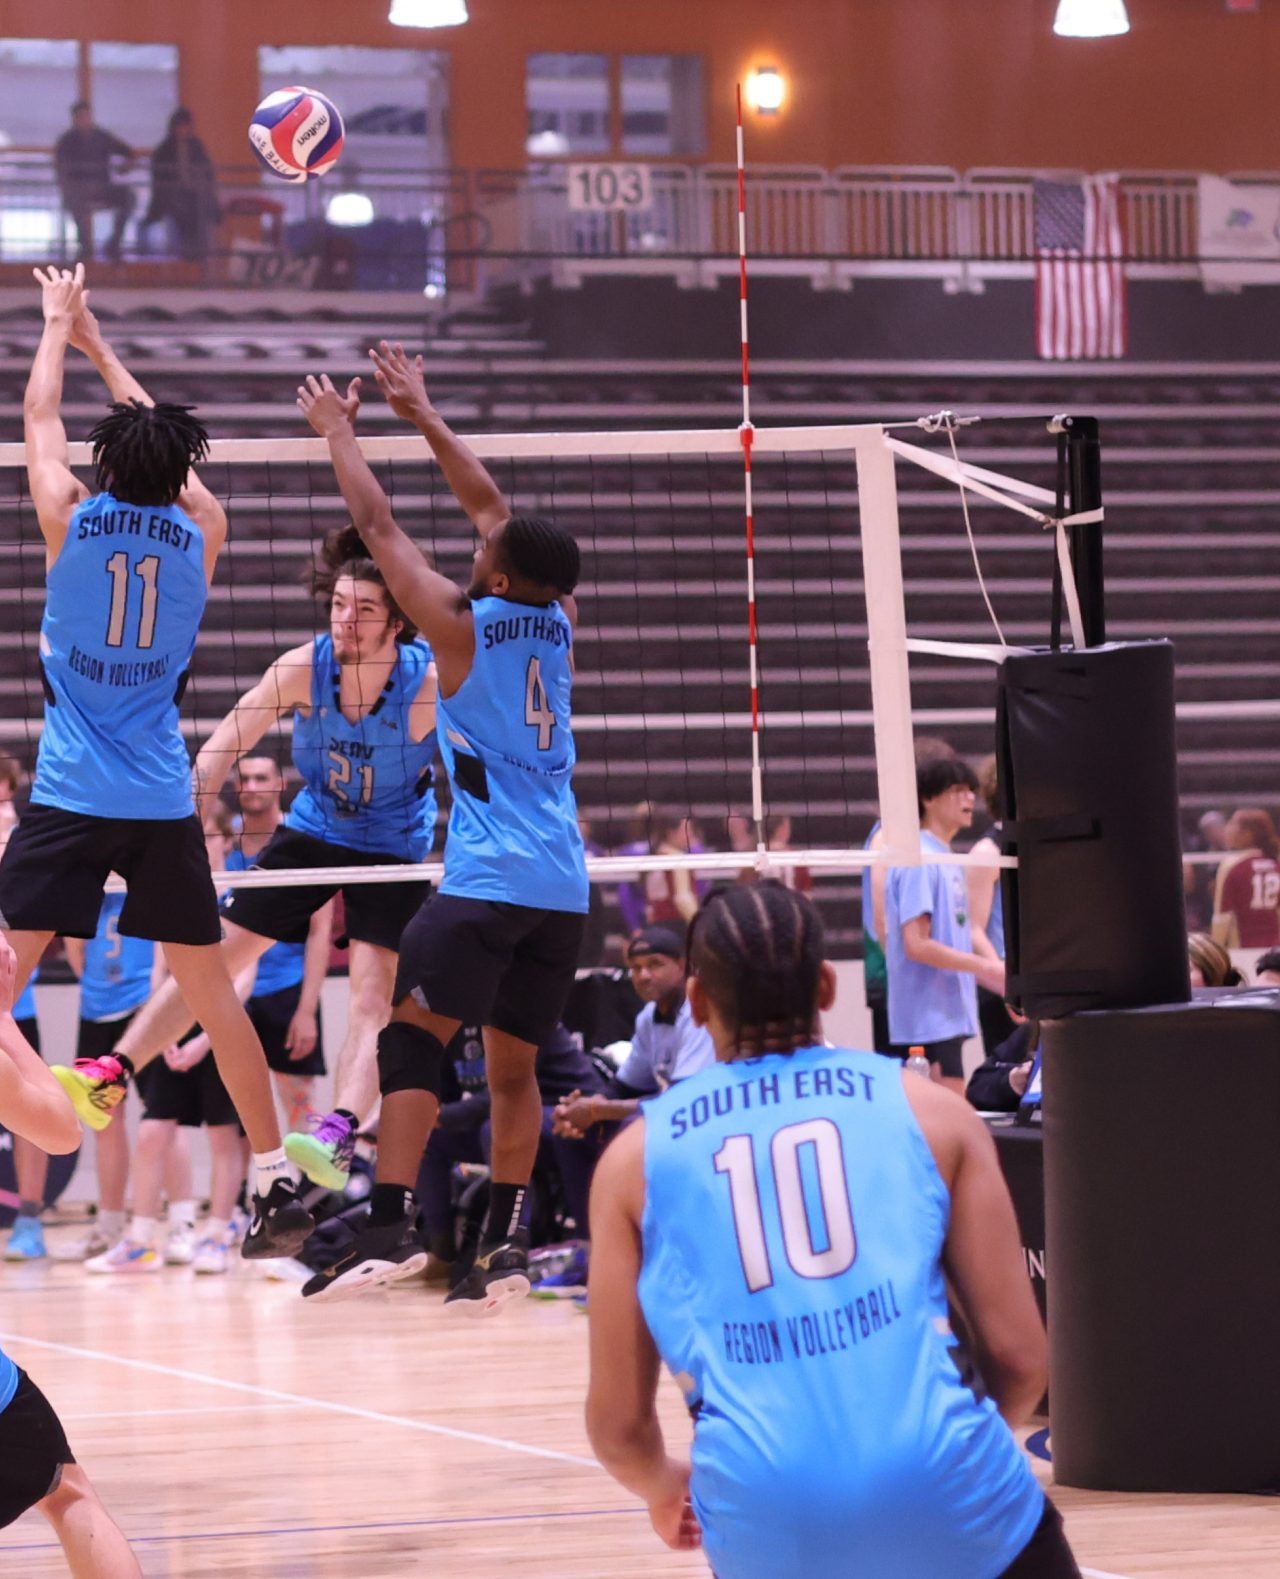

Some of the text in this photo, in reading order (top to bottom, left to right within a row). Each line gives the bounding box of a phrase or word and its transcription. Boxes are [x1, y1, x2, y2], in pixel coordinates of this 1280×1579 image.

[297, 115, 328, 146] molten
[577, 168, 643, 205] 103
[78, 511, 193, 552] SOUTH EAST
[105, 550, 160, 649] 11
[484, 616, 545, 650] SOUTH
[68, 645, 104, 684] REGION
[525, 654, 557, 751] 4
[328, 751, 373, 810] 21
[671, 1067, 875, 1139] SOUTH EAST
[712, 1117, 857, 1294] 10
[723, 1278, 901, 1365] REGION VOLLEYBALL
